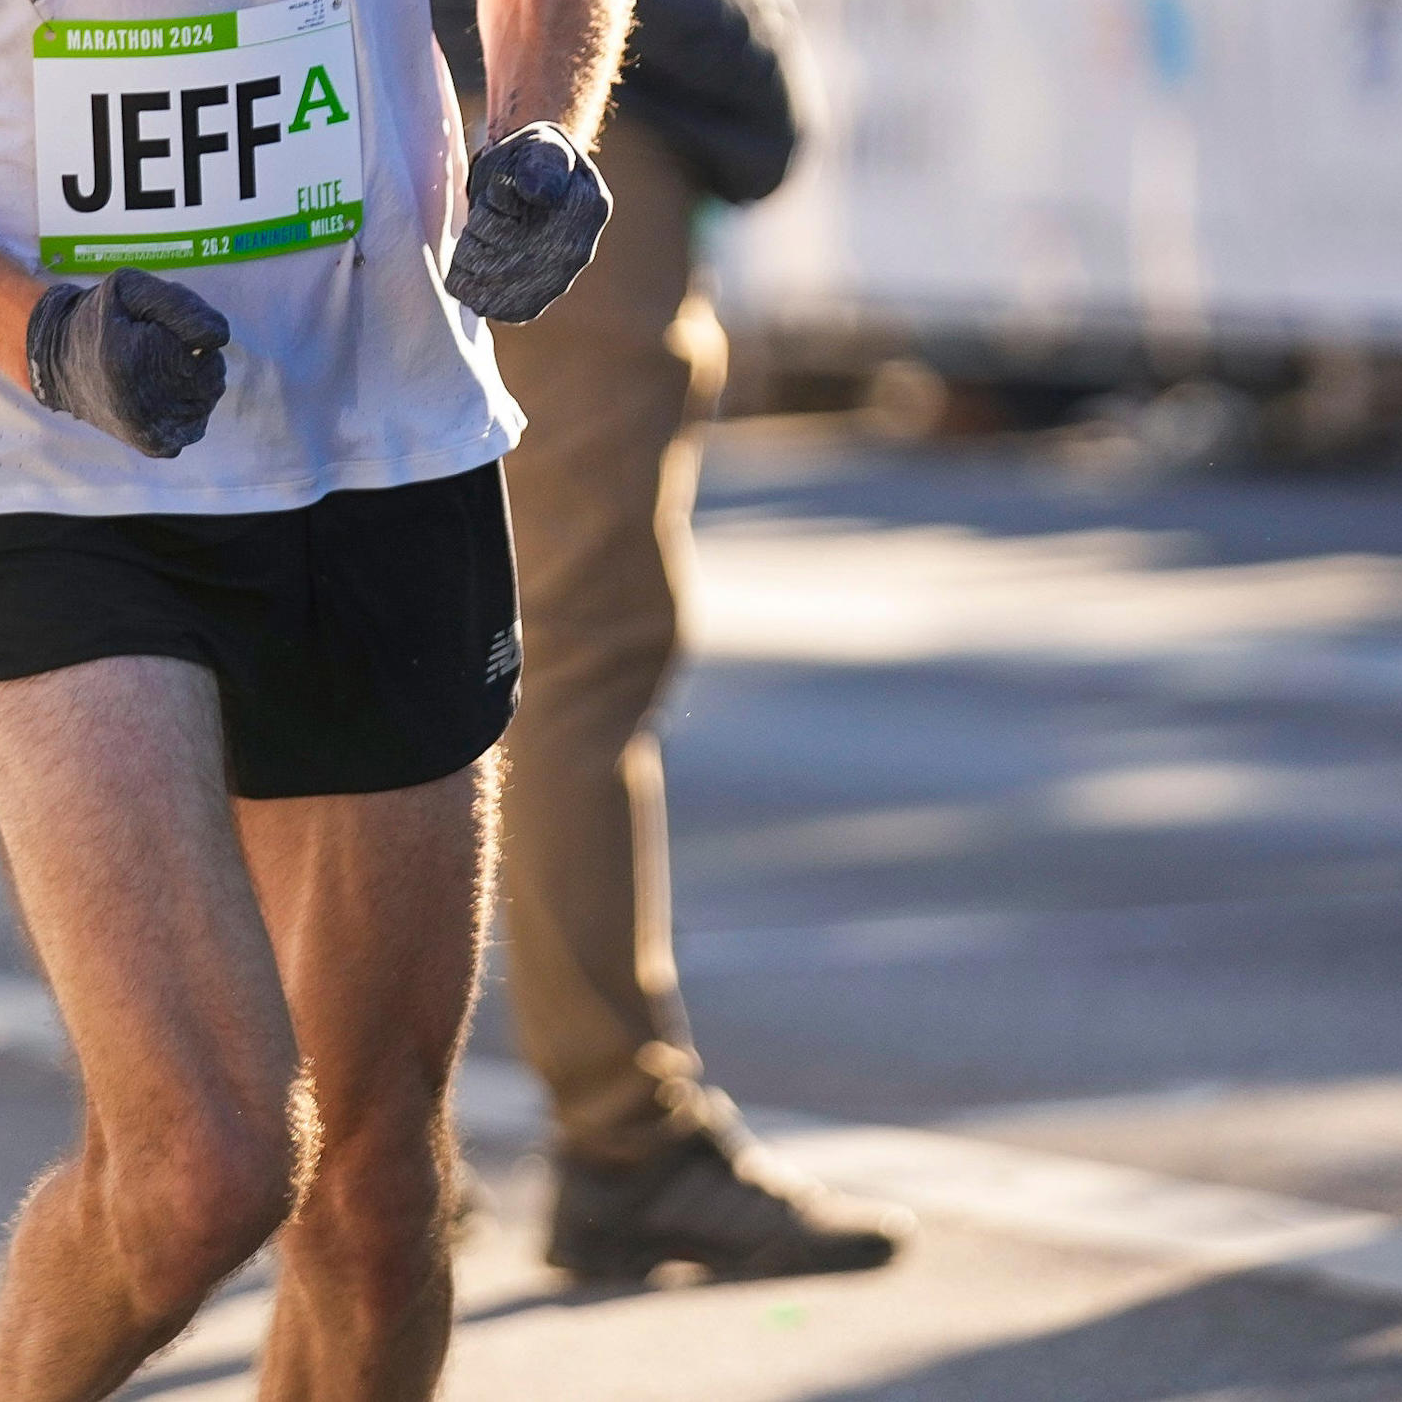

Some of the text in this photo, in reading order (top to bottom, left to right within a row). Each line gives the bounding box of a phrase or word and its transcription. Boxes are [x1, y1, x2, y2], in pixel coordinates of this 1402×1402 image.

[66, 23, 214, 51] MARATHON 2024
[288, 64, 350, 134] A
[61, 75, 282, 213] JEFF
[297, 179, 343, 213] ELITE
[202, 236, 230, 257] 26.2
[234, 223, 308, 253] MEANINGFUL
[311, 214, 345, 238] MILES
